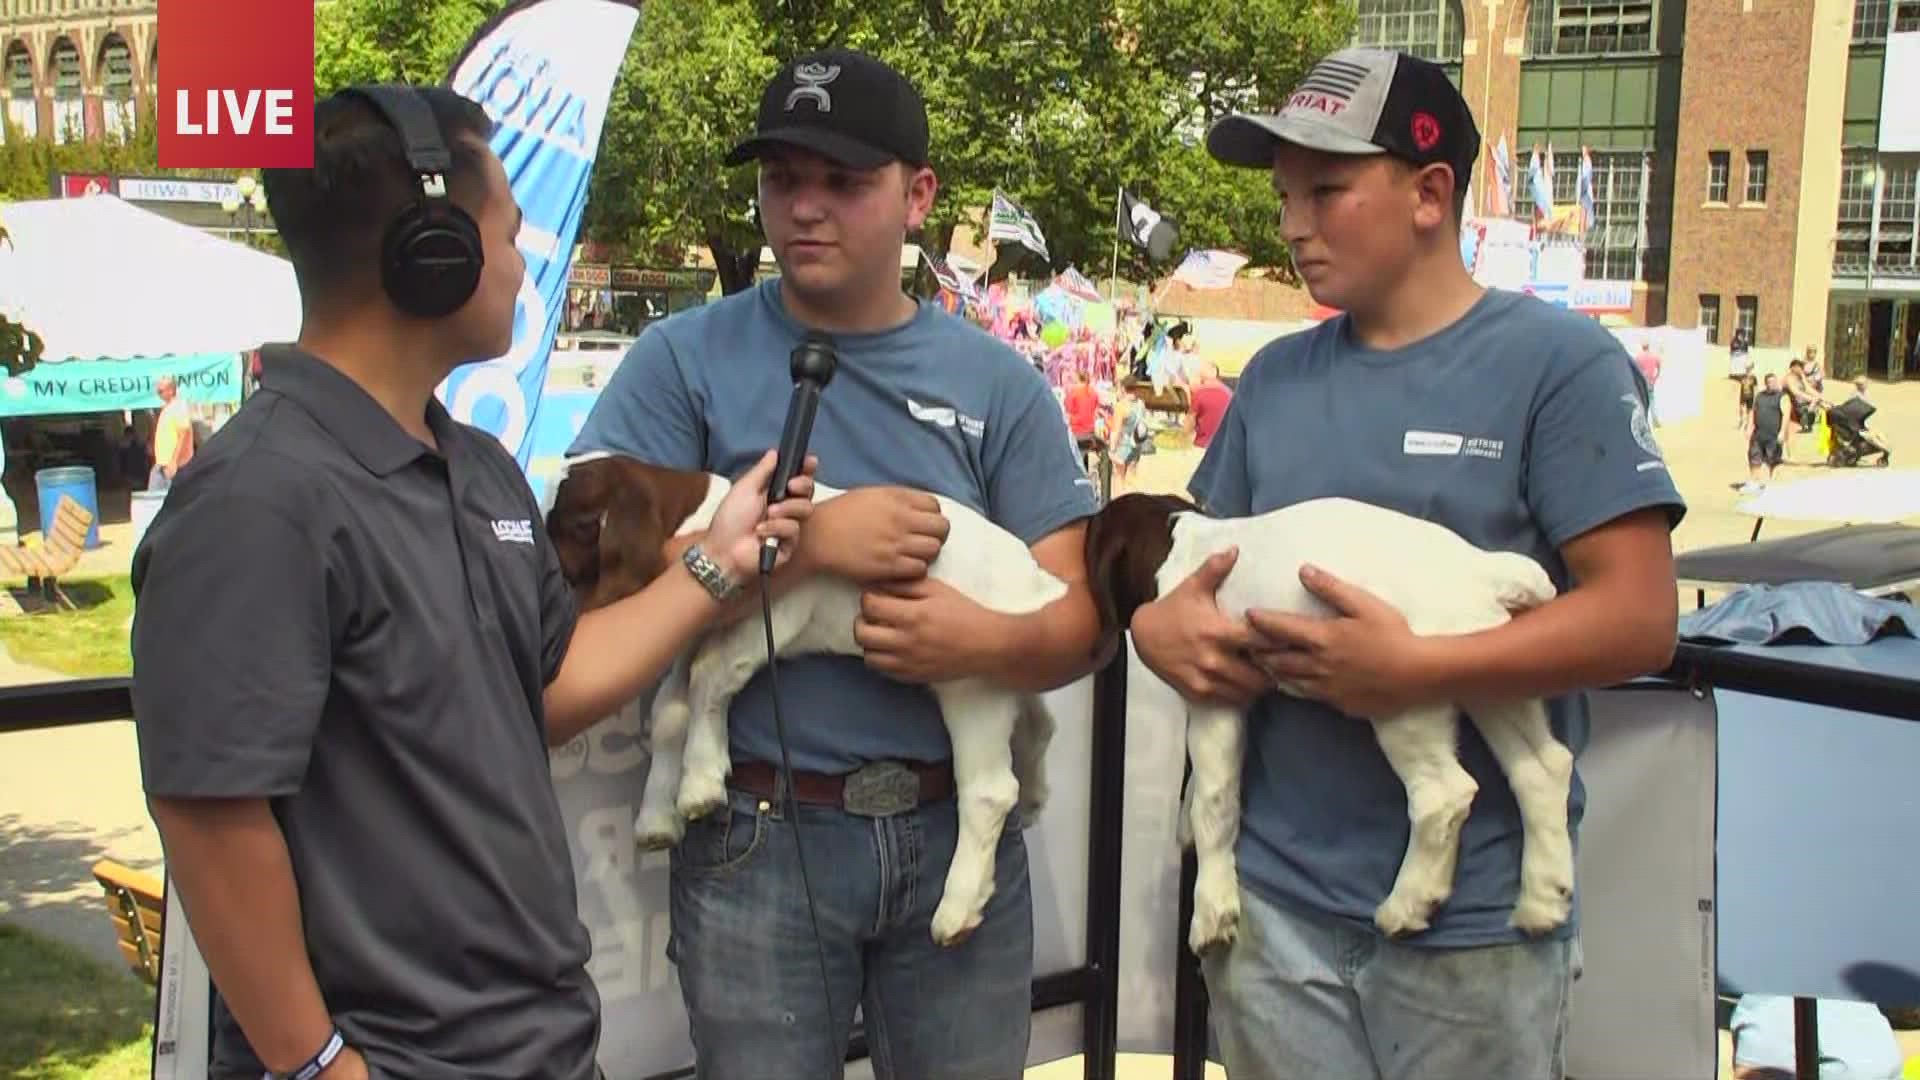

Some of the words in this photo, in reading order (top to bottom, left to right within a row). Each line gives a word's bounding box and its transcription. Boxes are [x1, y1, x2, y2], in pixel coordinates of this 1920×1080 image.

[1289, 94, 1346, 115] RIAT
[138, 183, 188, 198] IOWA
[34, 379, 68, 397] MY
[79, 375, 153, 396] CREDIT
